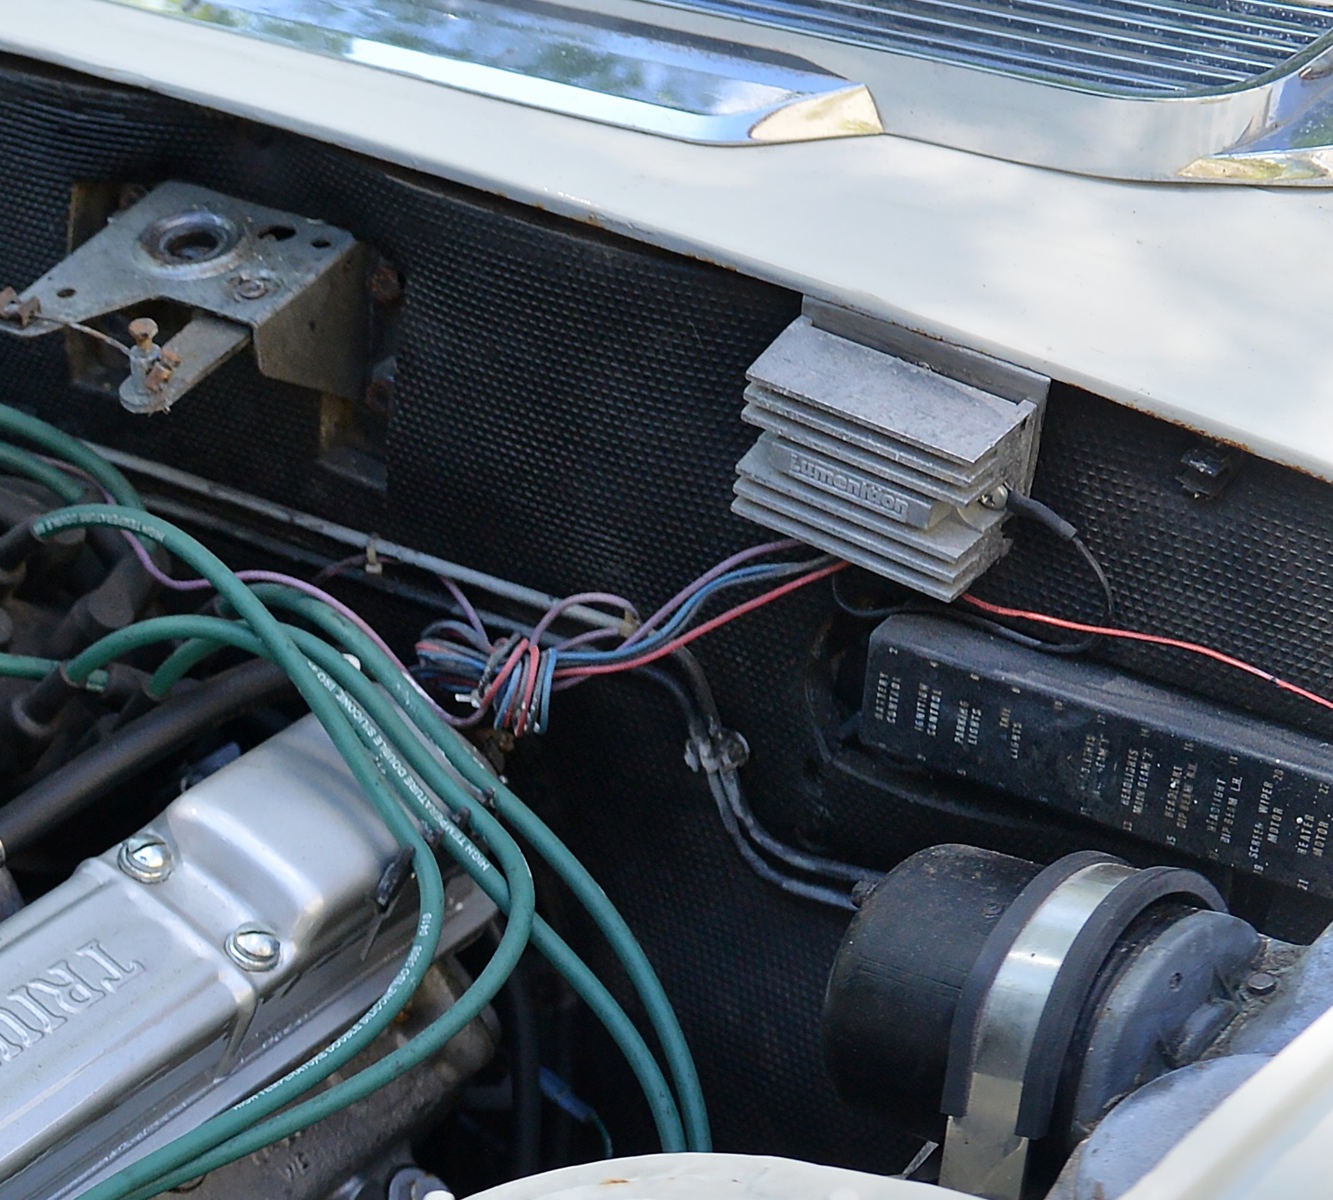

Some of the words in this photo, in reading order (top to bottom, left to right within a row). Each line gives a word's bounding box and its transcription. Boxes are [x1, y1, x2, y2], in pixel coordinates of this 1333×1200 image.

[789, 452, 909, 518] Lumenition
[967, 706, 982, 746] LIGHTS
[1119, 748, 1139, 806] HEADLIGHTS
[402, 772, 470, 848] TEMPERATURE
[1257, 780, 1274, 814] WIPER
[1266, 805, 1283, 843] MOTOR
[1312, 819, 1328, 857] MOTOR
[463, 841, 491, 871] HIGH
